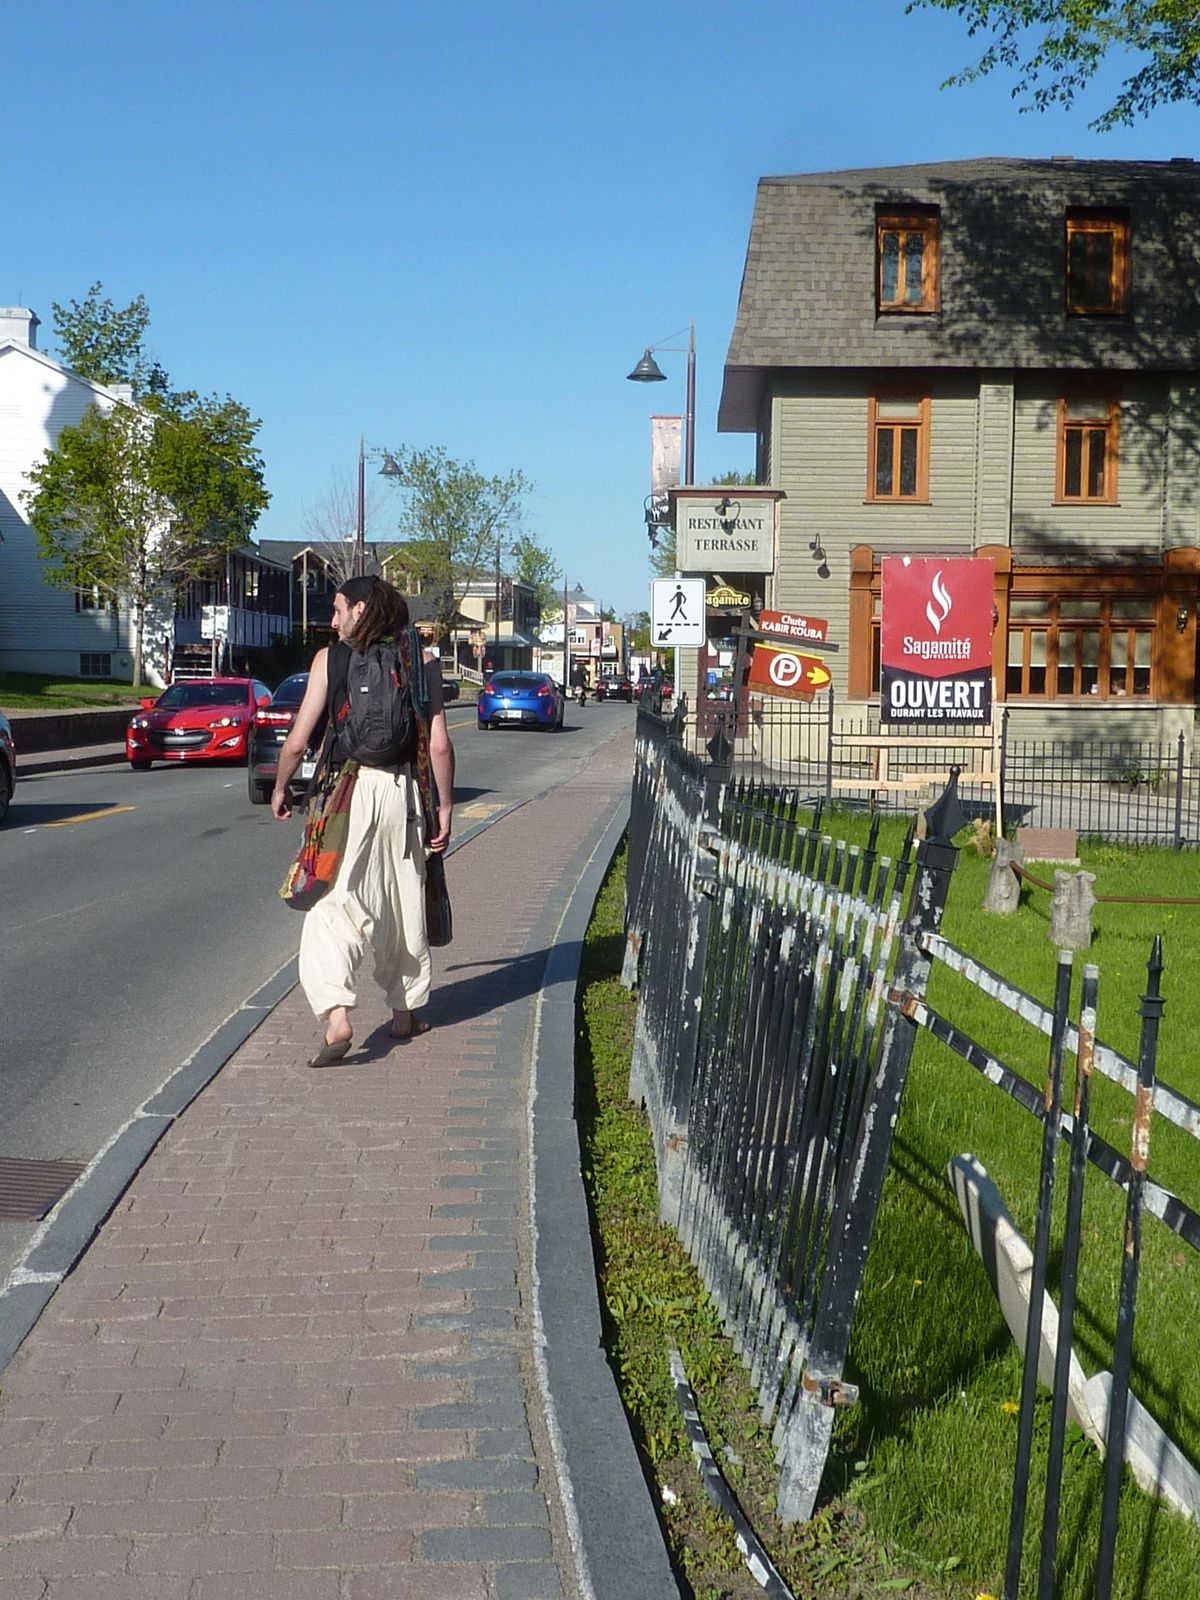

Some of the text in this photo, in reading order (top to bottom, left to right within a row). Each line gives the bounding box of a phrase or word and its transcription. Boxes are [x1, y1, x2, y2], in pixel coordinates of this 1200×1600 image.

[688, 518, 764, 530] RESTARANT
[694, 539, 759, 551] TERRASSE
[781, 615, 807, 627] Chute
[761, 621, 823, 640] KABIR KOUBA
[903, 636, 971, 659] Sagamité
[890, 680, 985, 708] OUVERT
[890, 708, 984, 719] DURANT LES TRAVAUX
